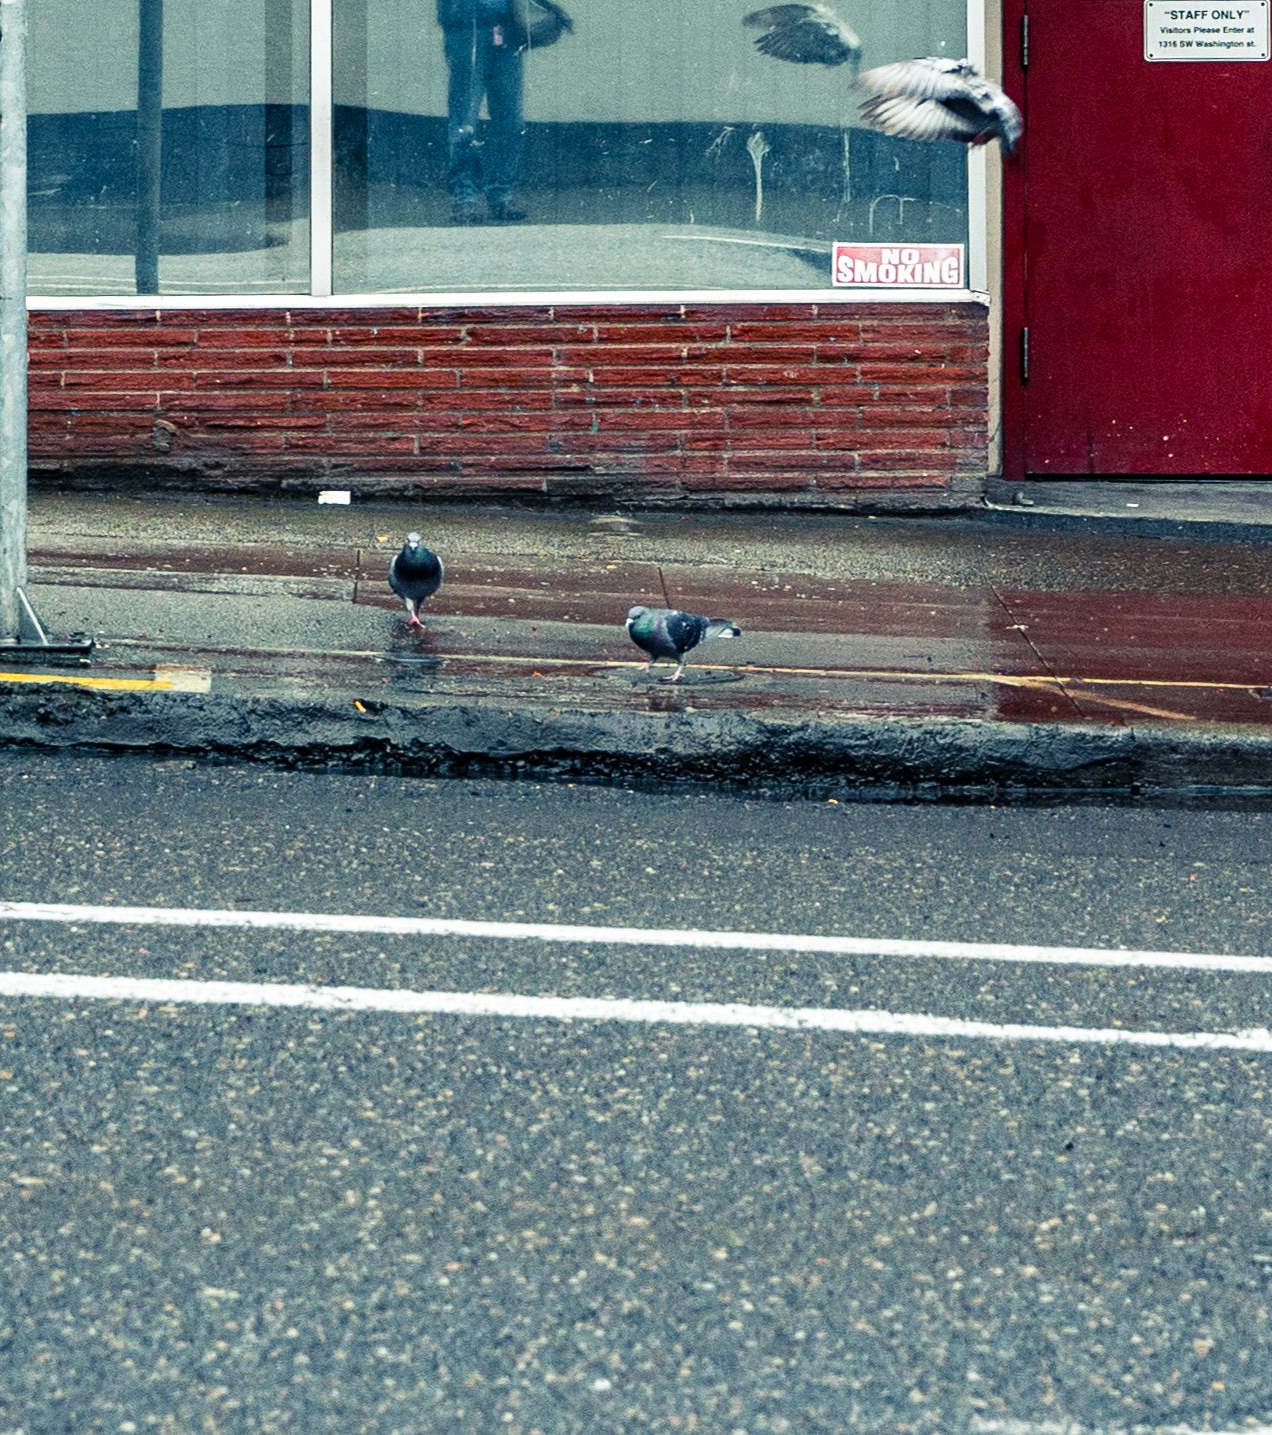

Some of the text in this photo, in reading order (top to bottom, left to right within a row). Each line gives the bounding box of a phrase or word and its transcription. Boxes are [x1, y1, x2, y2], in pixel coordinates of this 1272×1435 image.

[1159, 26, 1255, 34] Visitors Please Enter at
[1158, 40, 1178, 48] 1316
[1179, 40, 1193, 48] SW
[1195, 40, 1245, 49] Washington
[882, 248, 920, 265] NO
[837, 255, 959, 284] SMOKING
